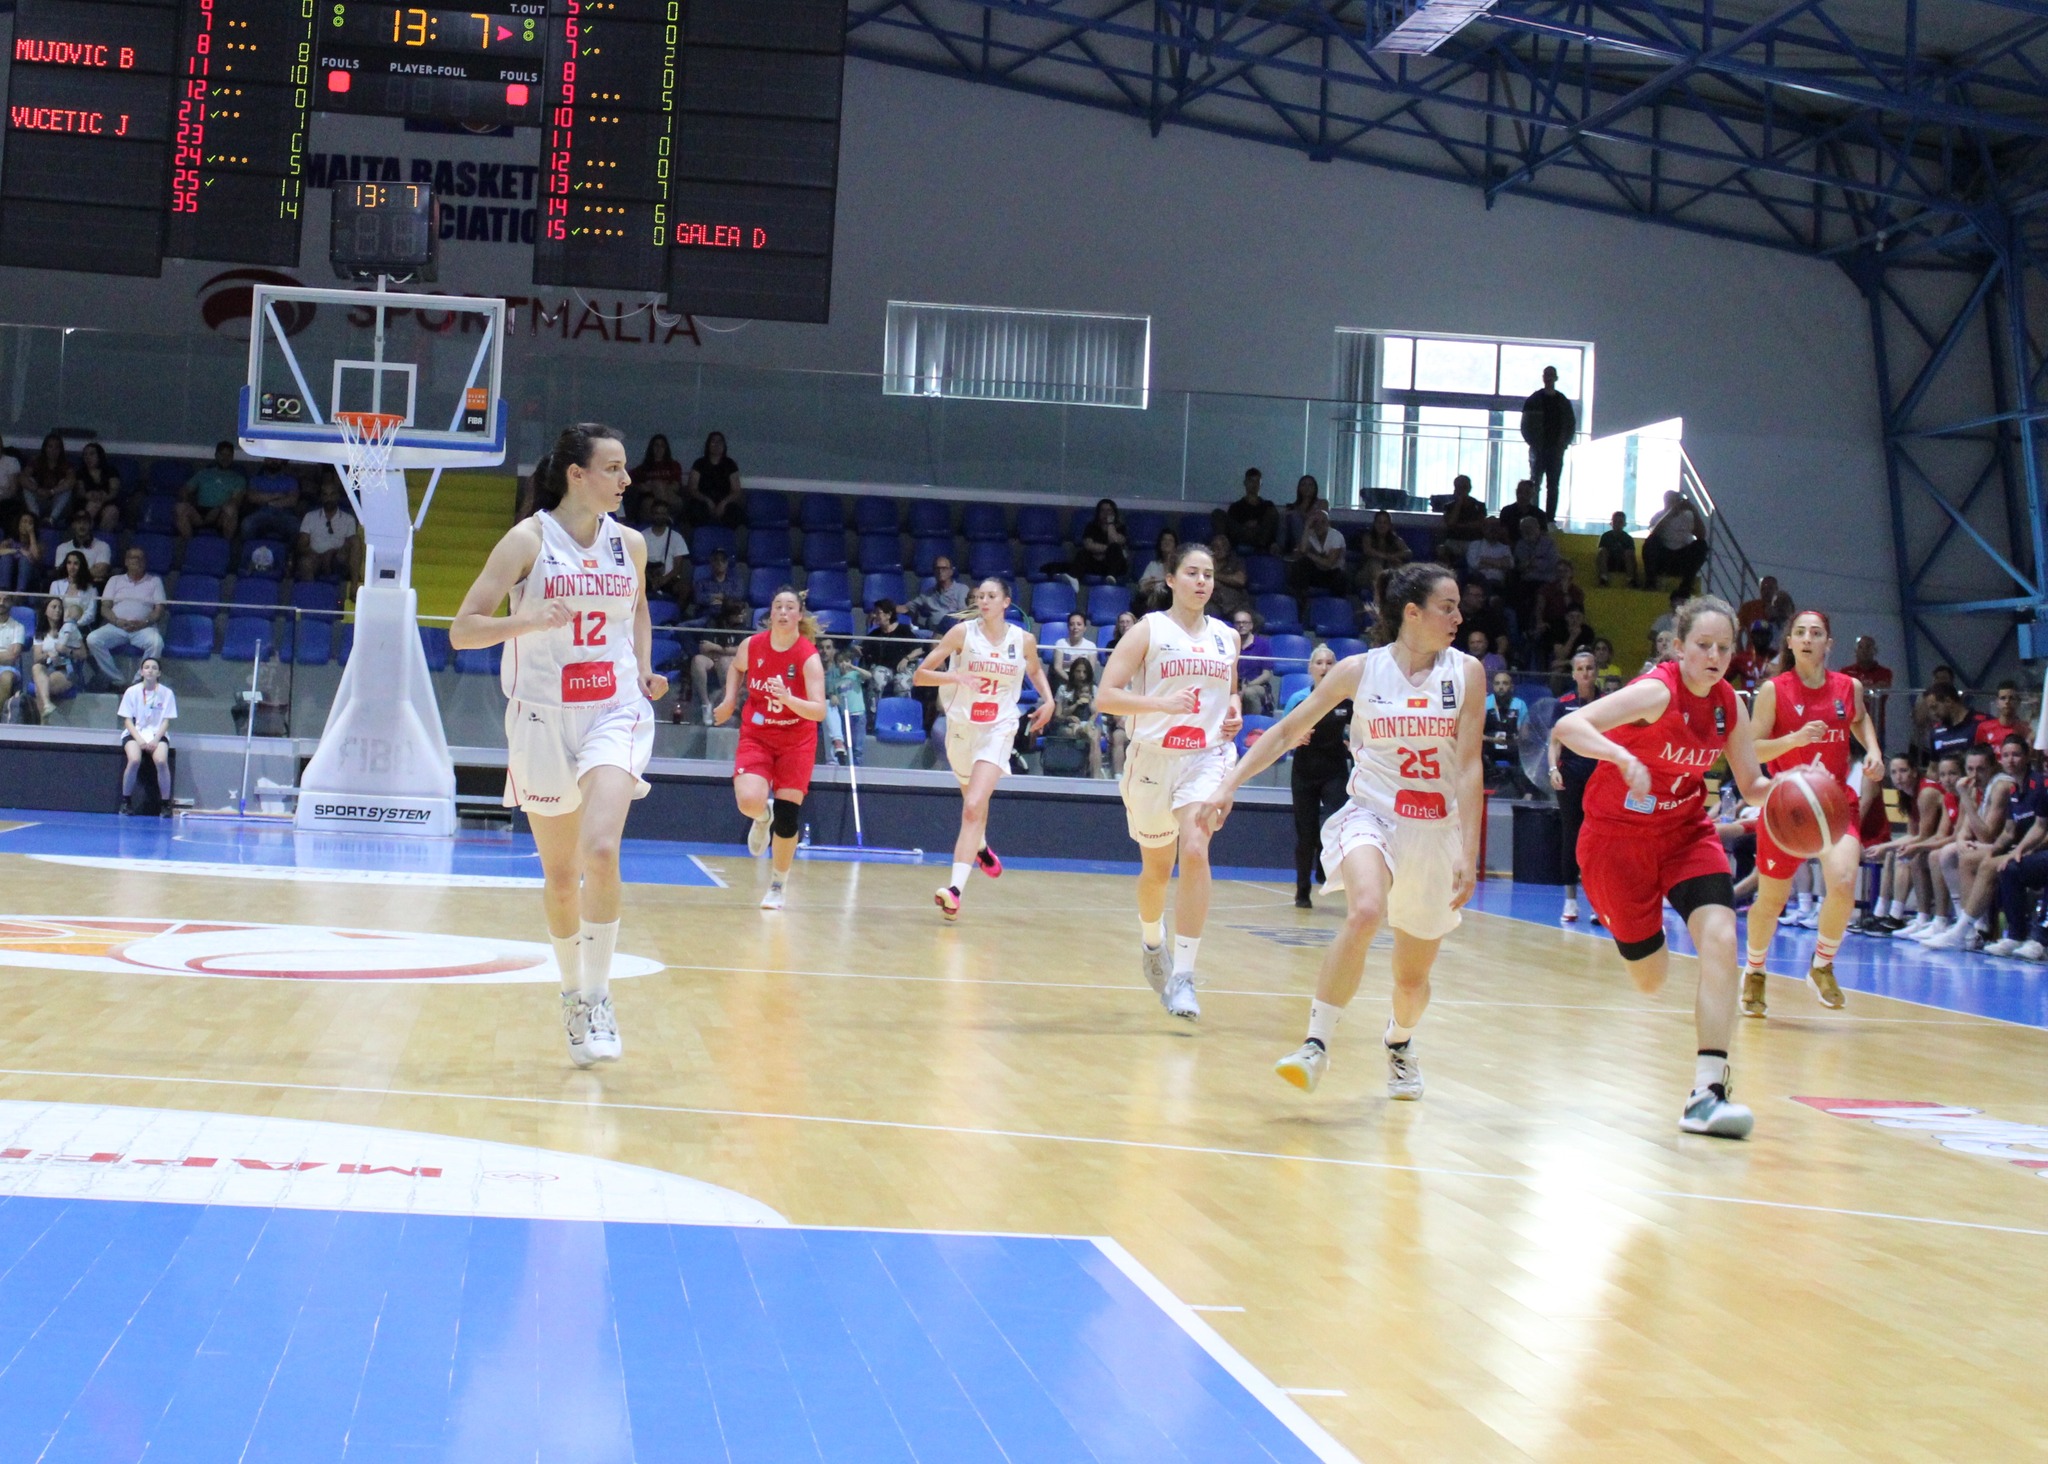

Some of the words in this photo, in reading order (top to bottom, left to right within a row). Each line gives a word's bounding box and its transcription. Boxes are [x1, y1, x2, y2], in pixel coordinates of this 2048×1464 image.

[510, 3, 545, 15] T.OUT
[667, 2, 678, 21] 0
[202, 12, 212, 31] 7
[470, 13, 490, 49] 7
[566, 18, 578, 38] 6
[666, 25, 677, 44] 0
[16, 38, 108, 66] MUJOVIC
[120, 47, 135, 69] B
[197, 34, 210, 54] 8
[567, 40, 578, 58] 7
[189, 57, 209, 75] 11
[291, 65, 308, 84] 10
[321, 57, 360, 69] FOULS
[390, 62, 467, 77] PLAYER-FOUL
[500, 70, 538, 82] FOULS
[563, 62, 576, 82] 8
[663, 69, 674, 88] 0
[188, 80, 207, 100] 12
[295, 89, 306, 108] 0
[562, 84, 575, 104] 9
[662, 91, 673, 111] 5
[11, 106, 103, 134] VUCETIC
[115, 115, 129, 135] J
[178, 101, 205, 121] 21
[554, 107, 573, 127] 10
[177, 124, 204, 144] 23
[553, 130, 572, 148] 11
[659, 137, 670, 156] 0
[175, 146, 202, 165] 24
[290, 156, 300, 174] 5
[551, 152, 570, 172] 12
[657, 159, 668, 178] 0
[173, 169, 199, 190] 25
[282, 179, 299, 197] 11
[550, 174, 569, 194] 13
[172, 191, 197, 212] 35
[280, 201, 298, 219] 14
[406, 185, 418, 208] 7
[549, 198, 567, 217] 14
[655, 204, 665, 223] 6
[547, 220, 566, 240] 15
[654, 226, 664, 246] 0
[676, 223, 741, 247] GALEA
[752, 228, 767, 249] D
[467, 416, 483, 425] FIBA
[573, 611, 606, 646] 12
[570, 670, 611, 690] m:tel
[967, 660, 1018, 677] MONTENEGRO
[979, 677, 999, 696] 21
[1168, 735, 1200, 749] m:tel
[1397, 747, 1441, 780] 25
[1401, 803, 1441, 819] m:tel
